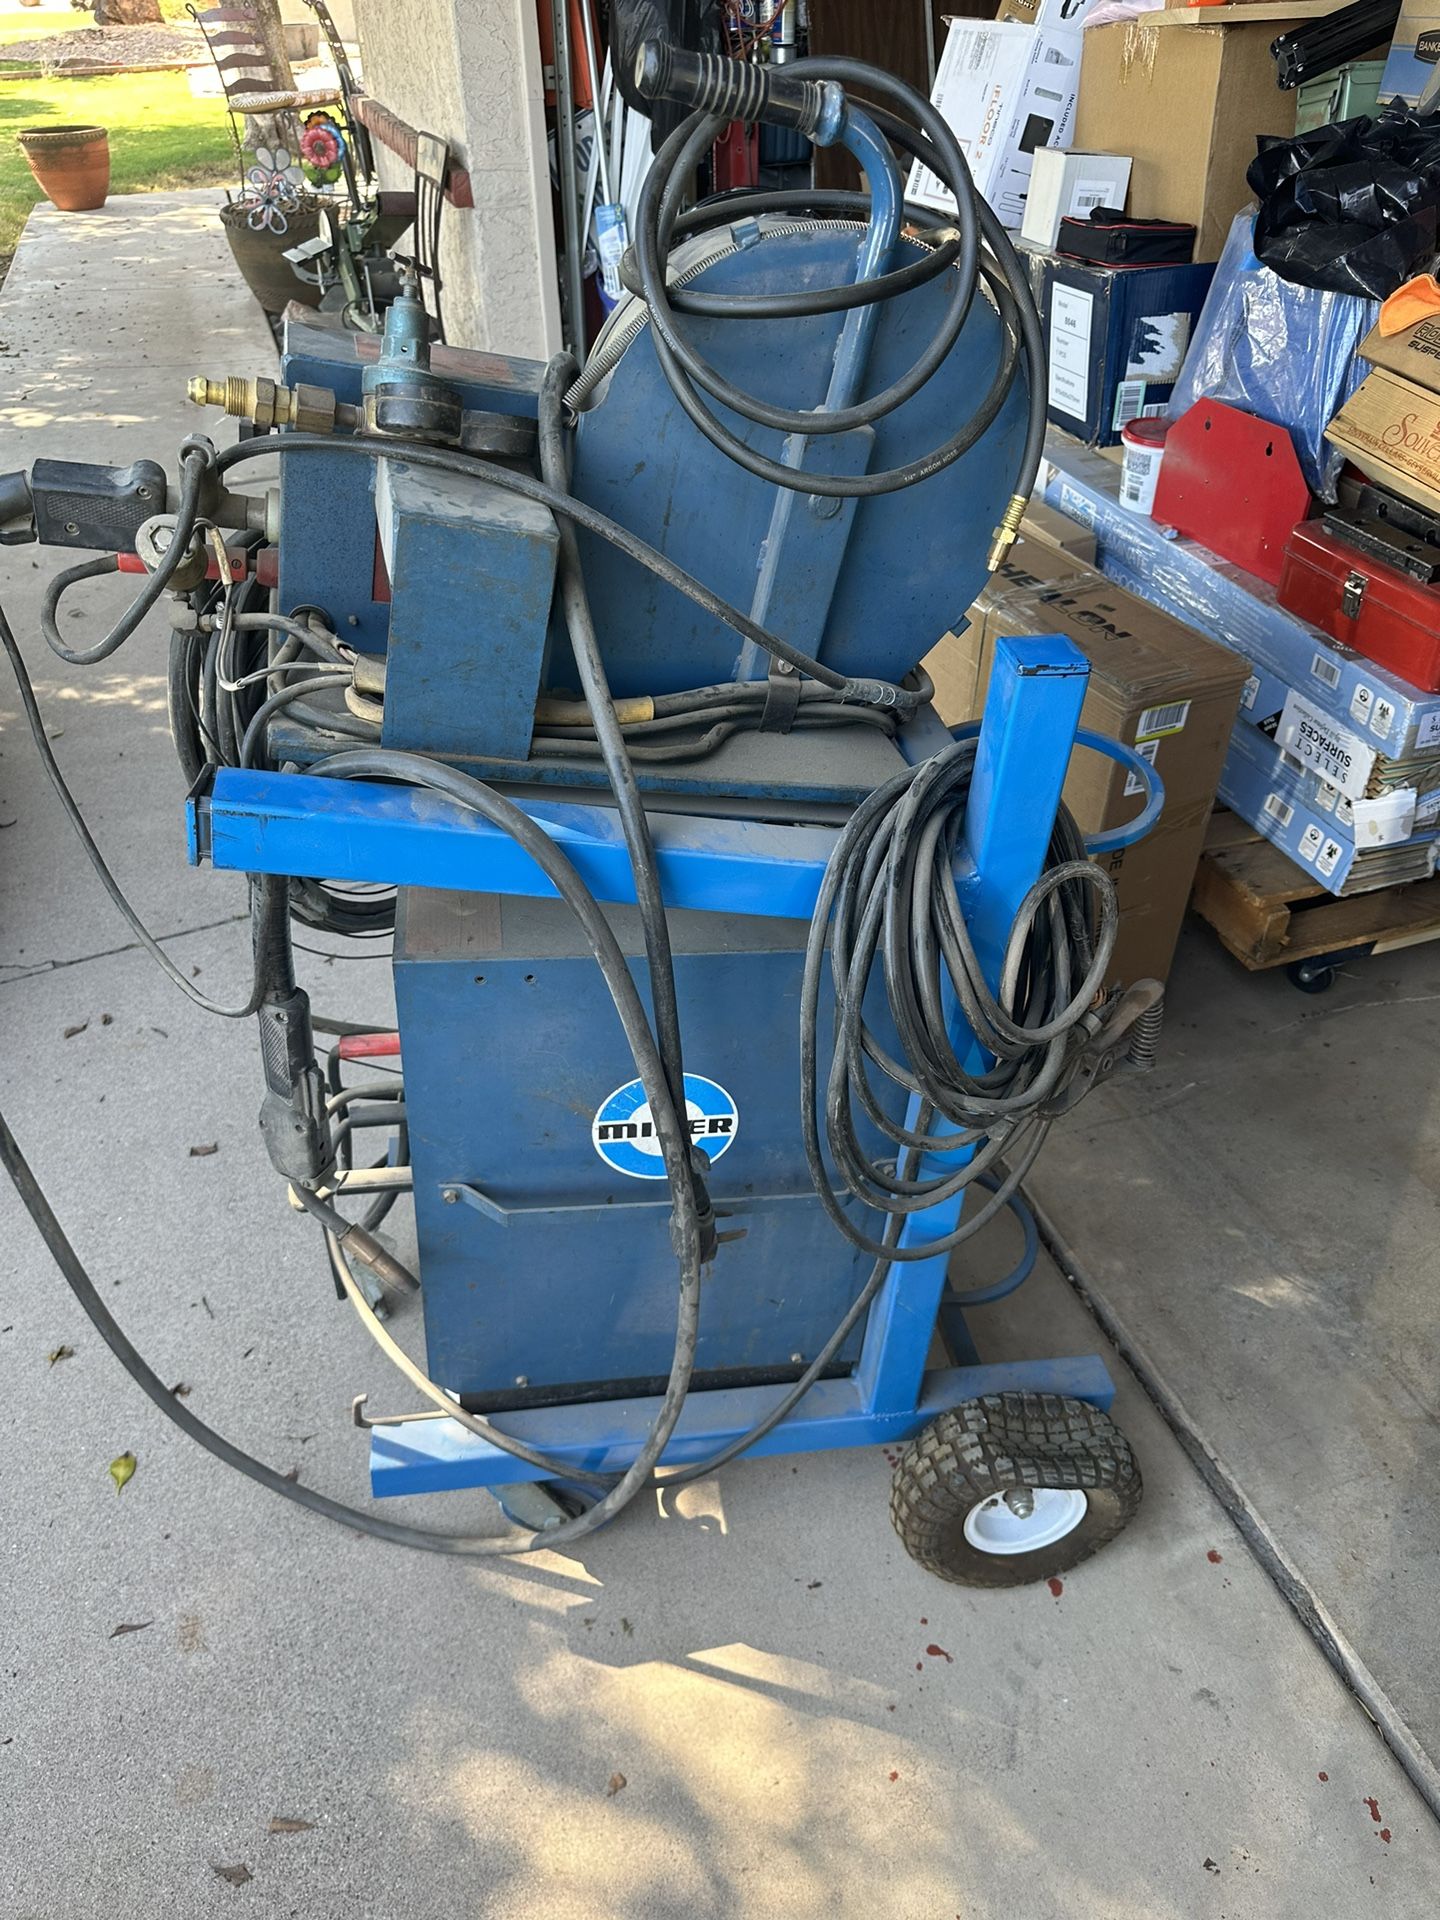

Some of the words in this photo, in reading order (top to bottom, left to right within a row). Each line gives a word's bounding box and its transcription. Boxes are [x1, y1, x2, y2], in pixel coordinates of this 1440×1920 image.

[1058, 94, 1075, 134] INCLUDED
[975, 151, 983, 160] 2
[649, 303, 663, 330] ARGON
[662, 331, 677, 351] HOSE
[920, 460, 941, 476] ARGON
[943, 449, 958, 464] HOSE
[1295, 738, 1348, 783] SELECT
[1299, 722, 1352, 767] SURFACES
